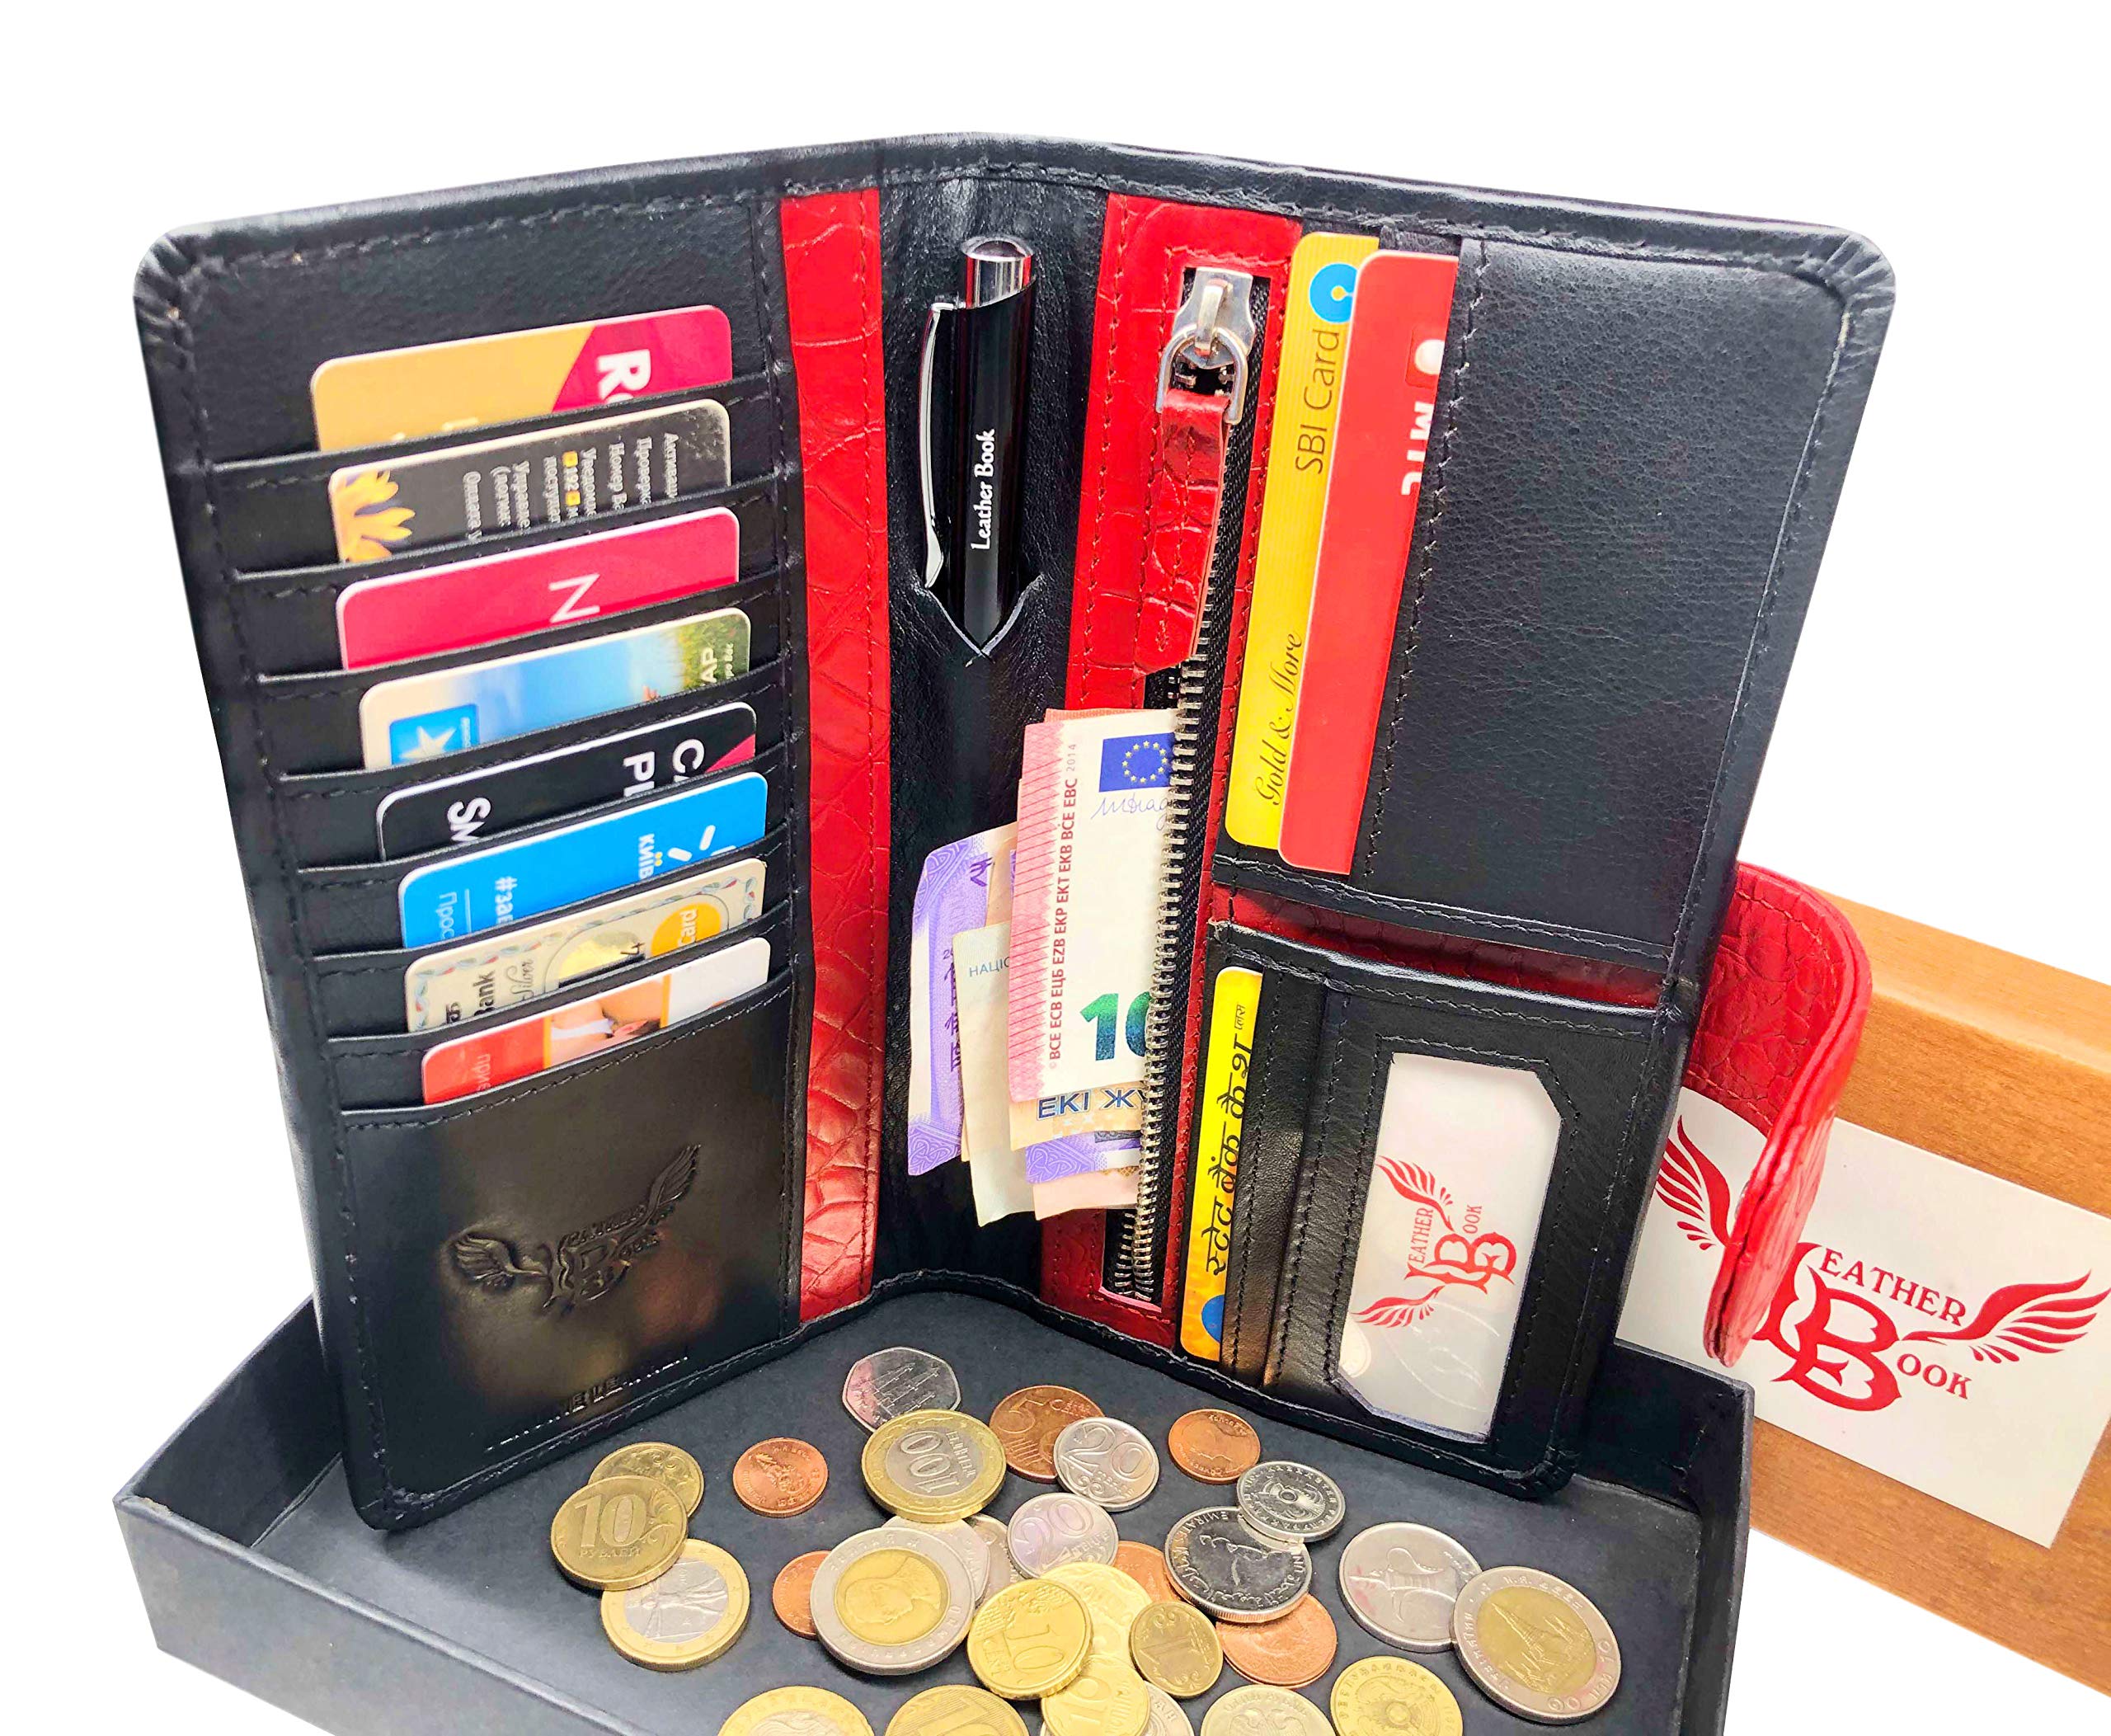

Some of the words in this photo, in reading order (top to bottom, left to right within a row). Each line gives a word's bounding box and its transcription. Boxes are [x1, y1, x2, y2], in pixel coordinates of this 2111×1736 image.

[1302, 327, 1341, 410] Card
[975, 427, 996, 480] Book
[1295, 420, 1323, 473] SBI
[969, 481, 994, 552] Leather
[1268, 633, 1302, 713] More
[1268, 716, 1292, 741] &
[1066, 743, 1078, 773] 2014
[1254, 739, 1287, 806] Gold
[1063, 778, 1079, 807] EBC
[1059, 844, 1074, 873] EKB
[1056, 907, 1070, 934] EKP
[1054, 939, 1070, 966] EZB
[1050, 1000, 1064, 1029] ECB
[1048, 1033, 1062, 1061] BCE
[900, 1428, 959, 1497] 100
[1061, 1424, 1151, 1483] 20
[574, 1492, 648, 1548] 10
[1013, 1496, 1097, 1570] 20
[1009, 1621, 1065, 1674] 10
